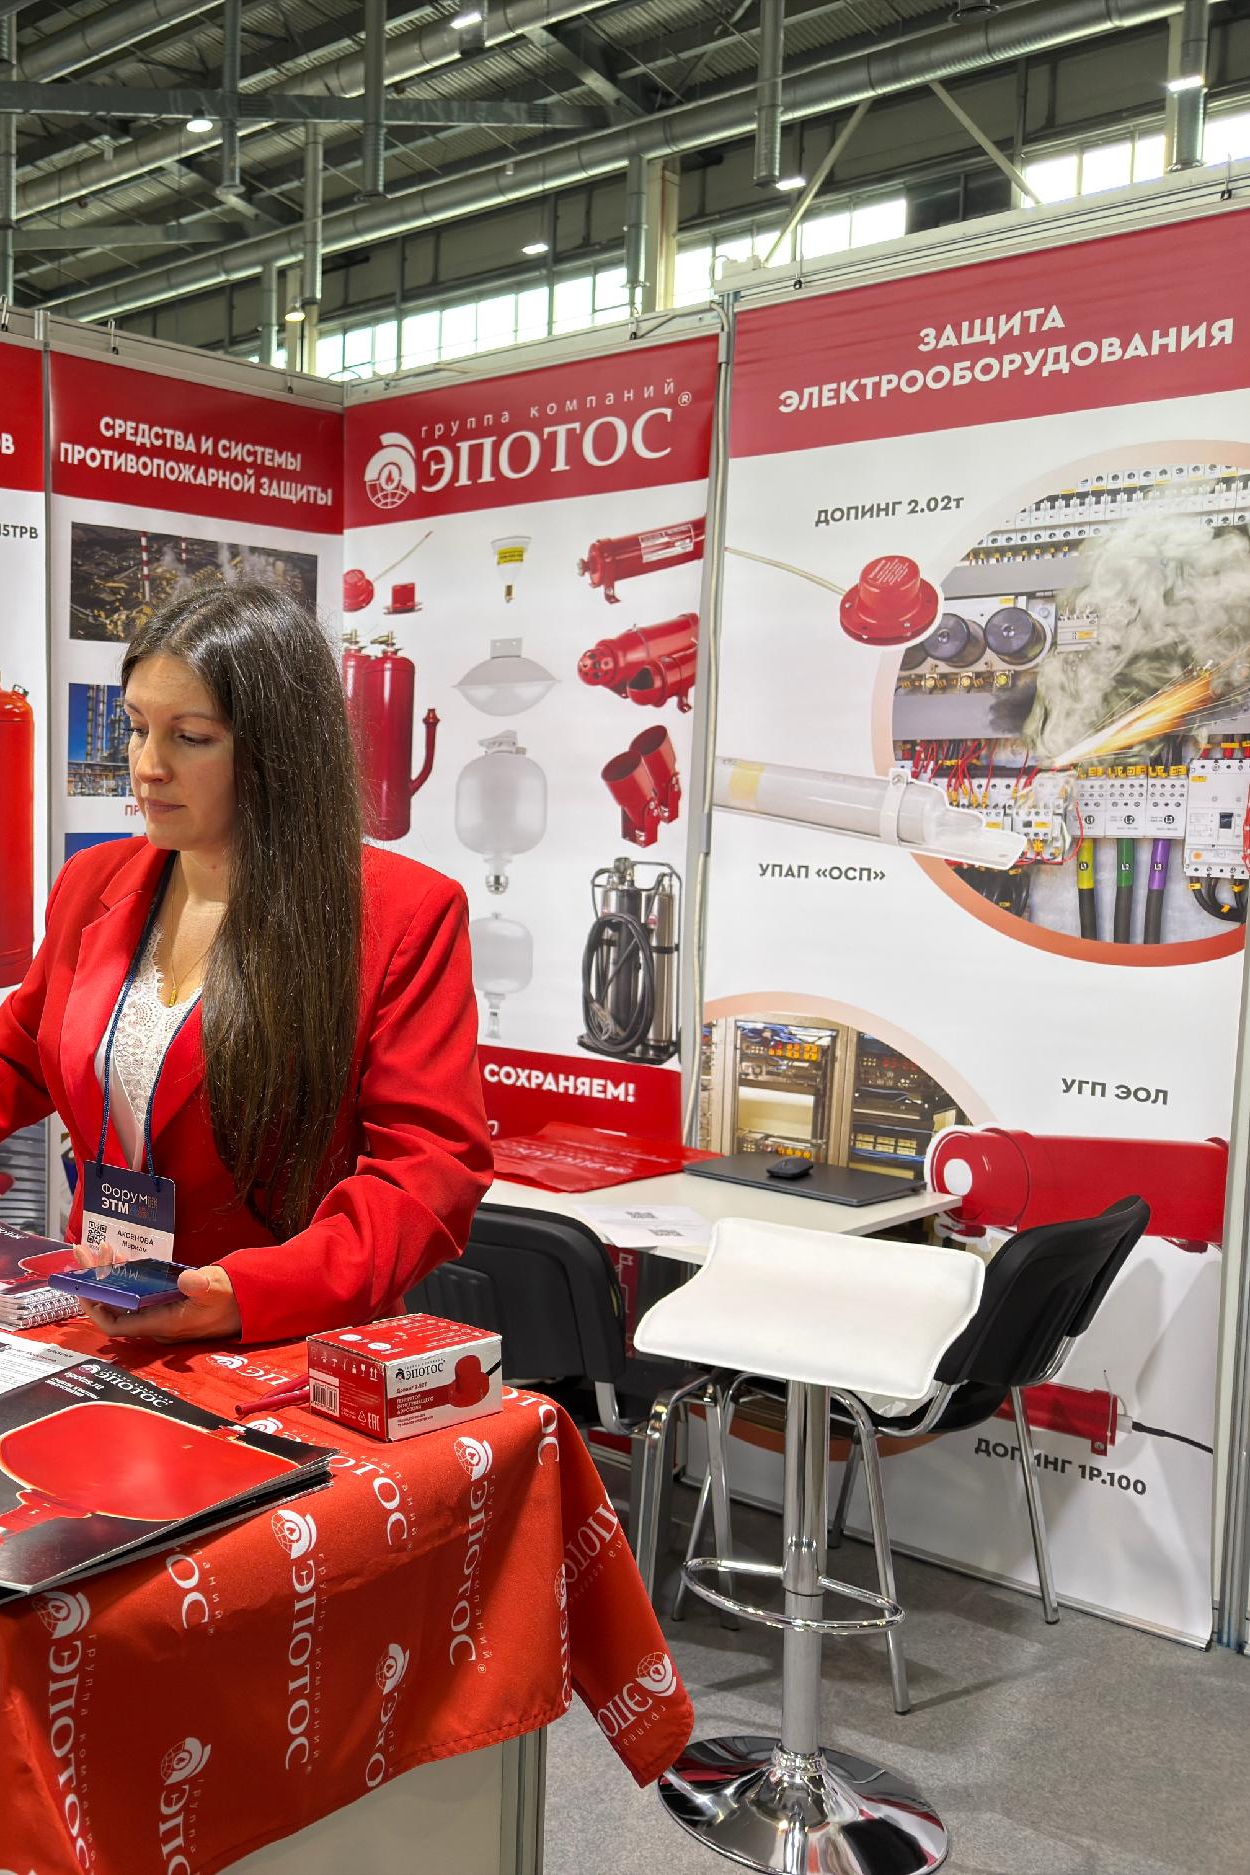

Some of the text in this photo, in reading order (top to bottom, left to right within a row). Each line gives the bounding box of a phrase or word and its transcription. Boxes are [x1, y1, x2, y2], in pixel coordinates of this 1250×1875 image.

[918, 304, 1066, 352] ЗАЩИТА
[777, 318, 1235, 414] ЭЛЕКТРООБОРУДОВАНИЯ
[421, 378, 674, 438] группа компаний
[100, 416, 302, 472] СРЕДСТВА И СИСТЕМЫ
[421, 407, 673, 493] ЭПОТОС
[60, 442, 333, 506] ПРОТИВОПОЖАРНОЙ ЗАЩИТЫ
[814, 494, 965, 527] ДОПИНГ 2.02т
[124, 804, 142, 817] ПР
[758, 862, 886, 883] УПАП «ОСП»
[484, 1063, 636, 1103] СОХРАНЯЕМ!
[1061, 1077, 1169, 1106] УГП ЭОЛ
[101, 1183, 148, 1205] Форум
[101, 1197, 129, 1214] ЭТМ
[405, 1362, 444, 1381] ЭПОТОС
[450, 1481, 488, 1666] ЭПОТОС
[285, 1560, 317, 1770] ЭПОТОС
[598, 1683, 653, 1738] ЭПО
[49, 1641, 90, 1869] ЭПОТОС
[158, 1784, 191, 1875] ЭПО
